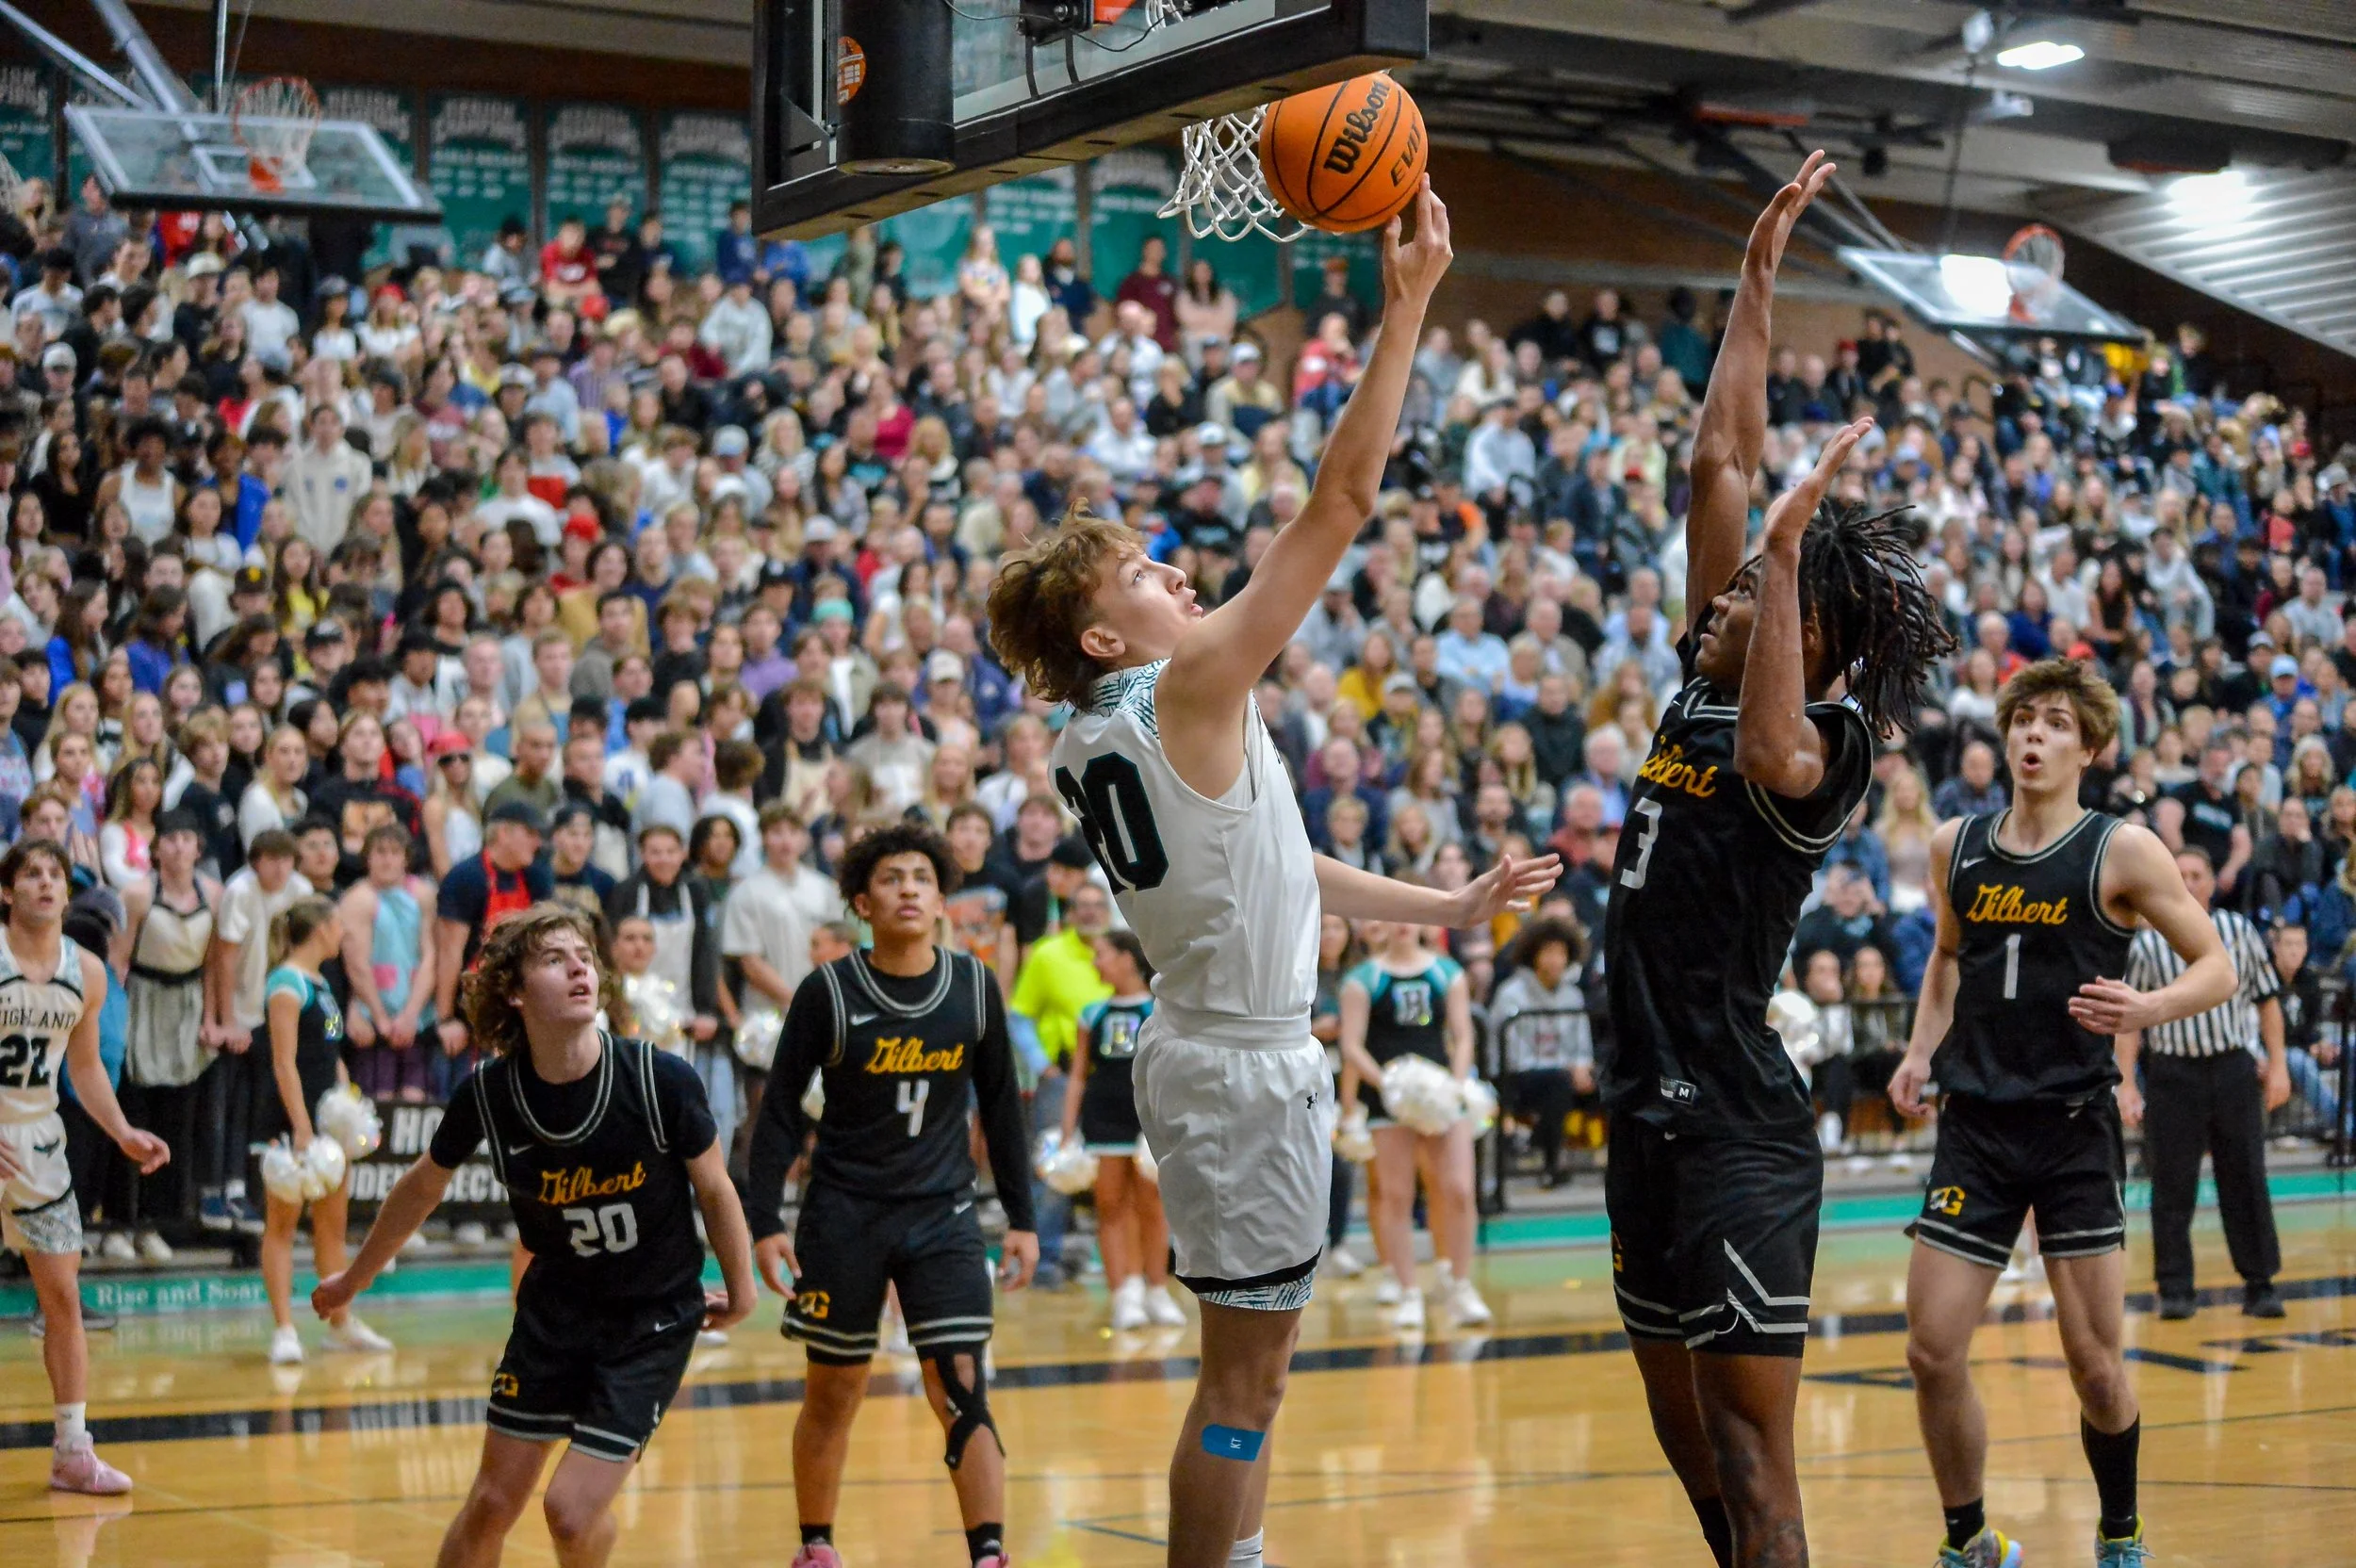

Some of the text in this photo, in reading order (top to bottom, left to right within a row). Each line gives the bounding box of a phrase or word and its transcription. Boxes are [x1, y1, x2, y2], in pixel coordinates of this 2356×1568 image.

[1323, 81, 1390, 174] Wilson
[1620, 797, 1662, 890] 3
[1966, 884, 2068, 924] Gilbert
[2004, 933, 2021, 999] 1
[0, 1007, 76, 1030] IGHLAND
[863, 1036, 964, 1073] Gilbert
[896, 1079, 929, 1137] 4
[1678, 1086, 1690, 1098] M
[537, 1161, 646, 1205] Gilbert
[562, 1202, 639, 1257] 20
[156, 1280, 201, 1303] and
